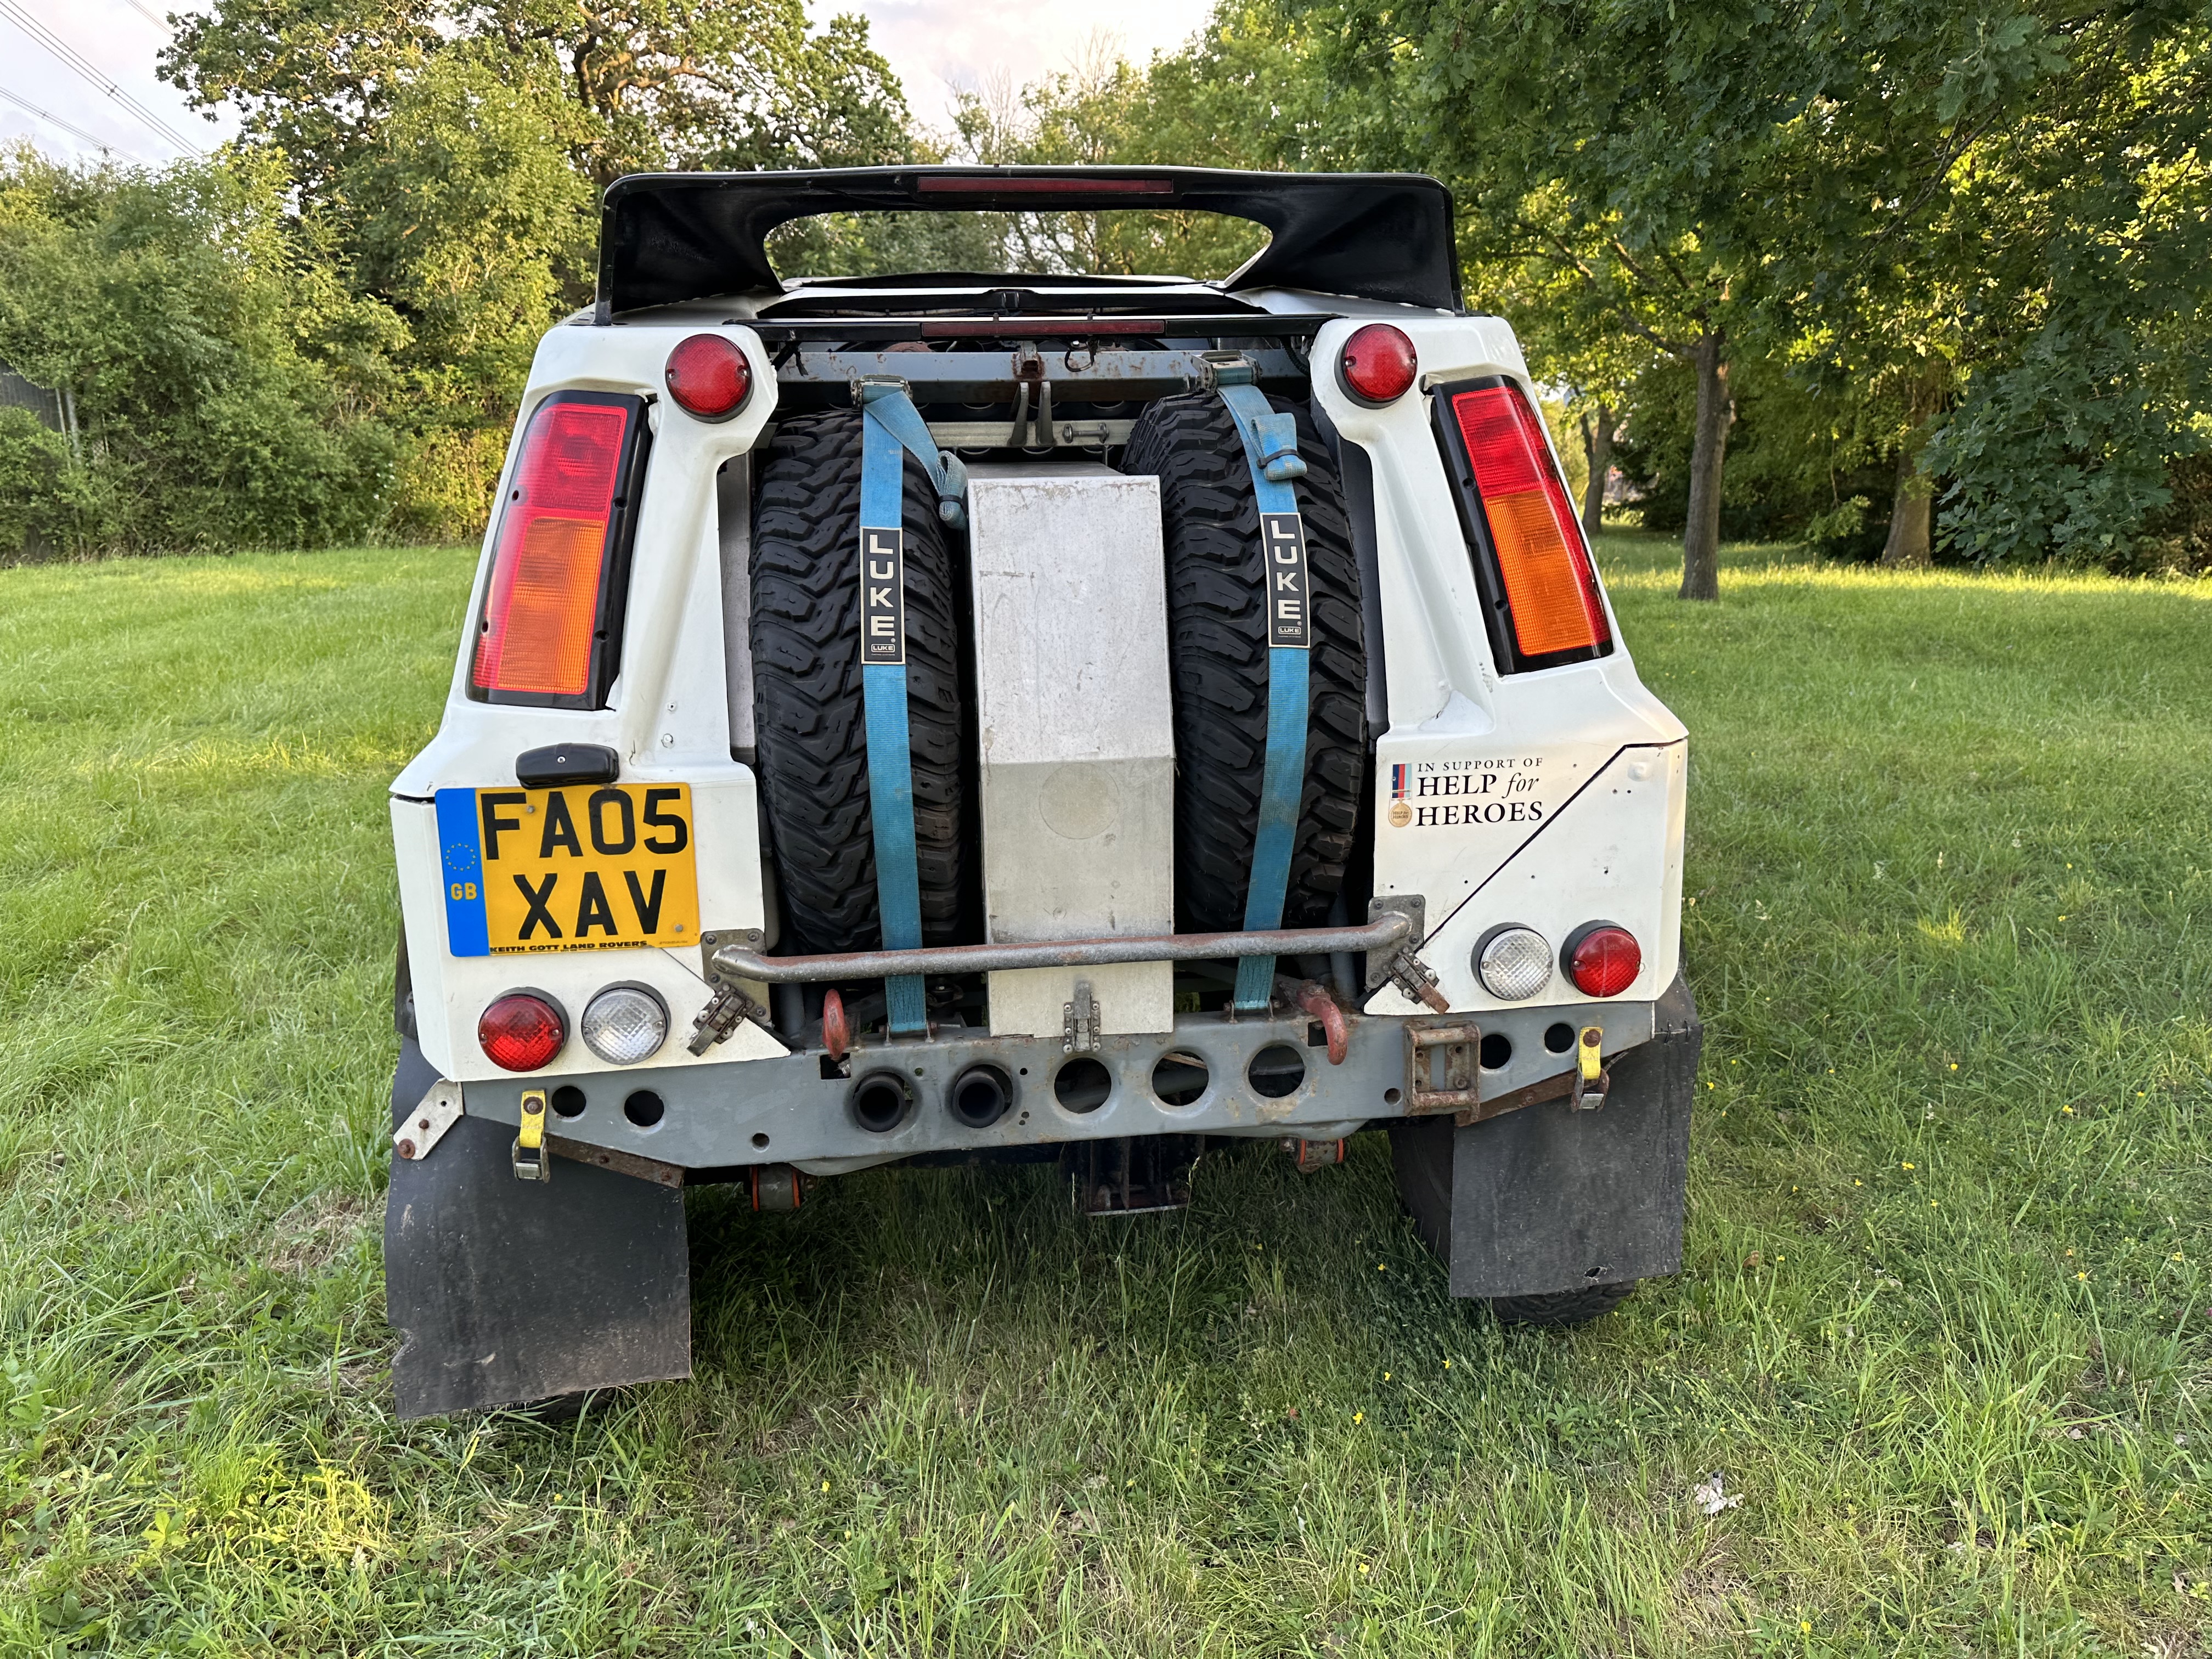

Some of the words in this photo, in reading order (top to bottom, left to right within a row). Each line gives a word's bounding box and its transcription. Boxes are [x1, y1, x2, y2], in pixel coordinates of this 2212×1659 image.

[870, 534, 895, 636] LUKE
[1271, 520, 1301, 619] LUKE
[1416, 774, 1497, 797] HELP
[1501, 772, 1539, 799] for
[1418, 763, 1435, 772] IN
[1443, 759, 1515, 771] SUPPORT
[1523, 758, 1543, 767] OF
[481, 788, 688, 860] FA05
[1415, 800, 1543, 827] HEROES
[450, 882, 477, 901] GB
[513, 869, 667, 940] XAV
